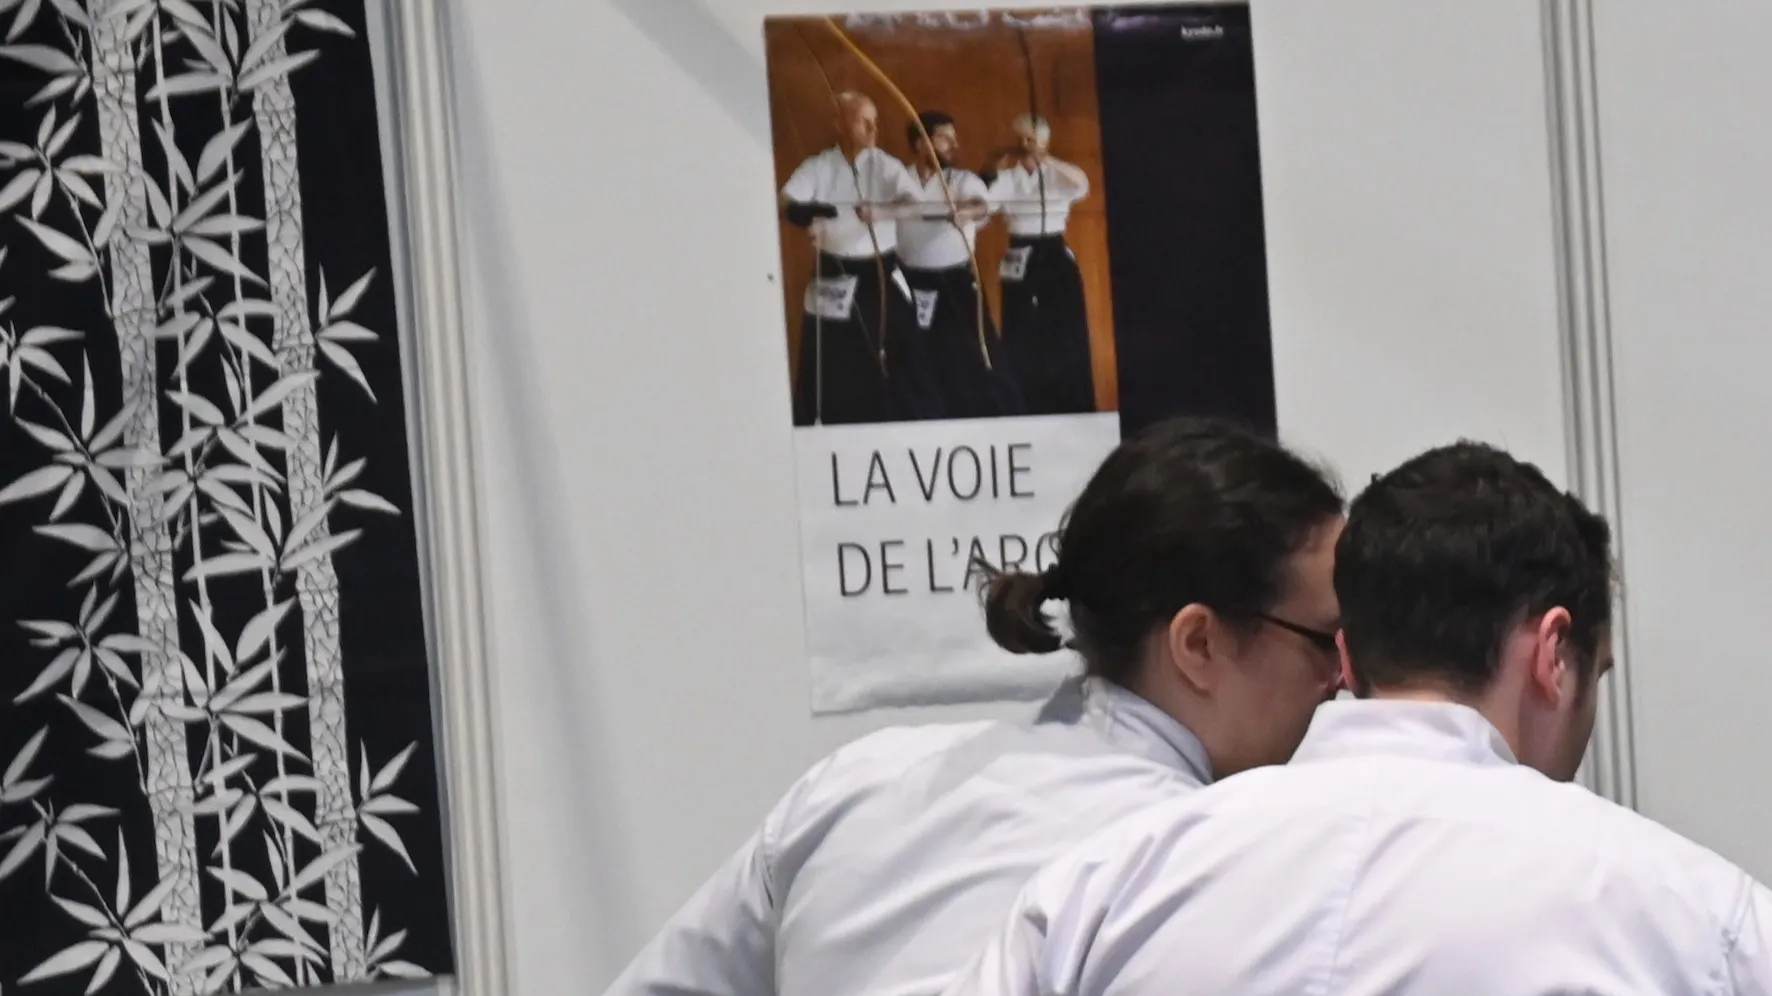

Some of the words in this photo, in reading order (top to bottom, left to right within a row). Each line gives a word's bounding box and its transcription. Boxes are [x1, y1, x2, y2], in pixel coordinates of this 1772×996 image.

[831, 449, 897, 507] LA
[908, 442, 1035, 503] VOIE
[837, 540, 909, 597] DE
